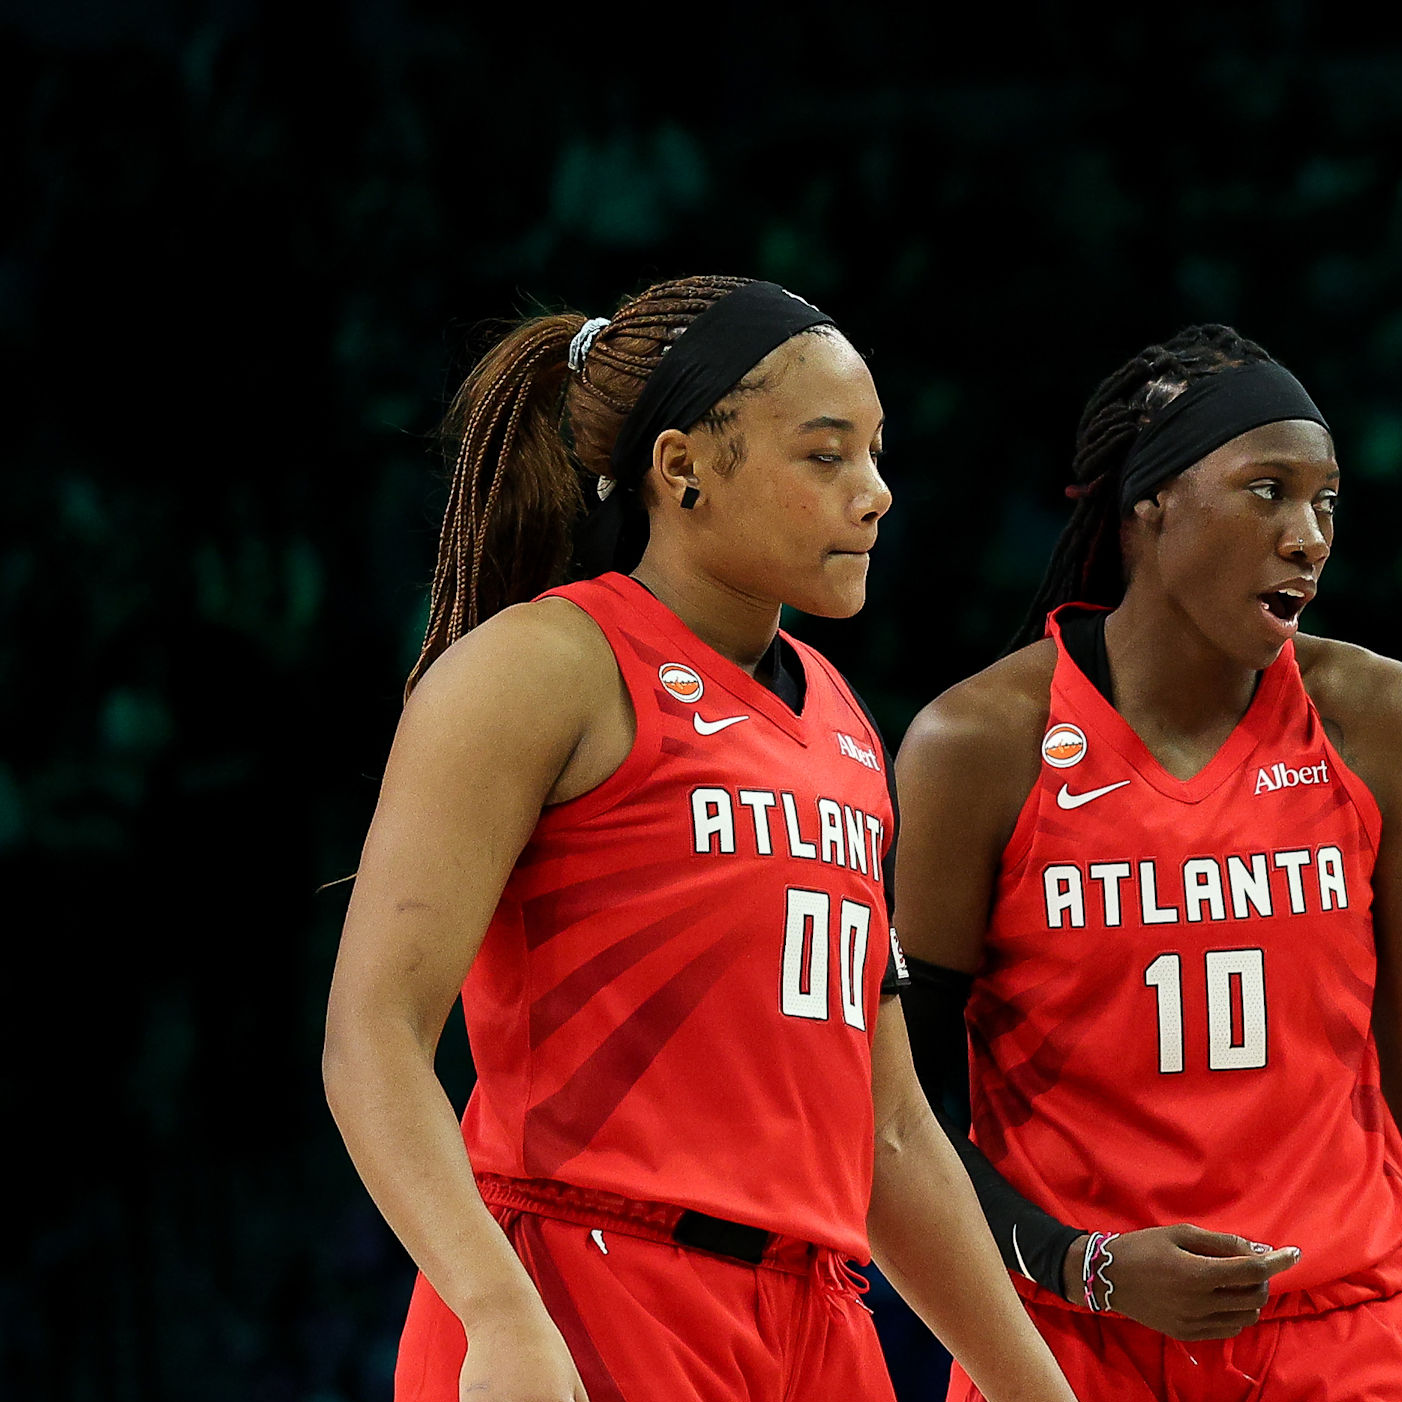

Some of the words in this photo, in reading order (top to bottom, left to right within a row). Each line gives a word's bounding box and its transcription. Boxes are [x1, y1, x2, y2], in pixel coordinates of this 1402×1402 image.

[836, 731, 882, 772] Albert
[1253, 758, 1330, 796] Albert
[690, 787, 885, 883] ATLANT
[1042, 845, 1349, 929] ATLANTA
[781, 888, 871, 1033] 00
[1144, 948, 1267, 1074] 10
